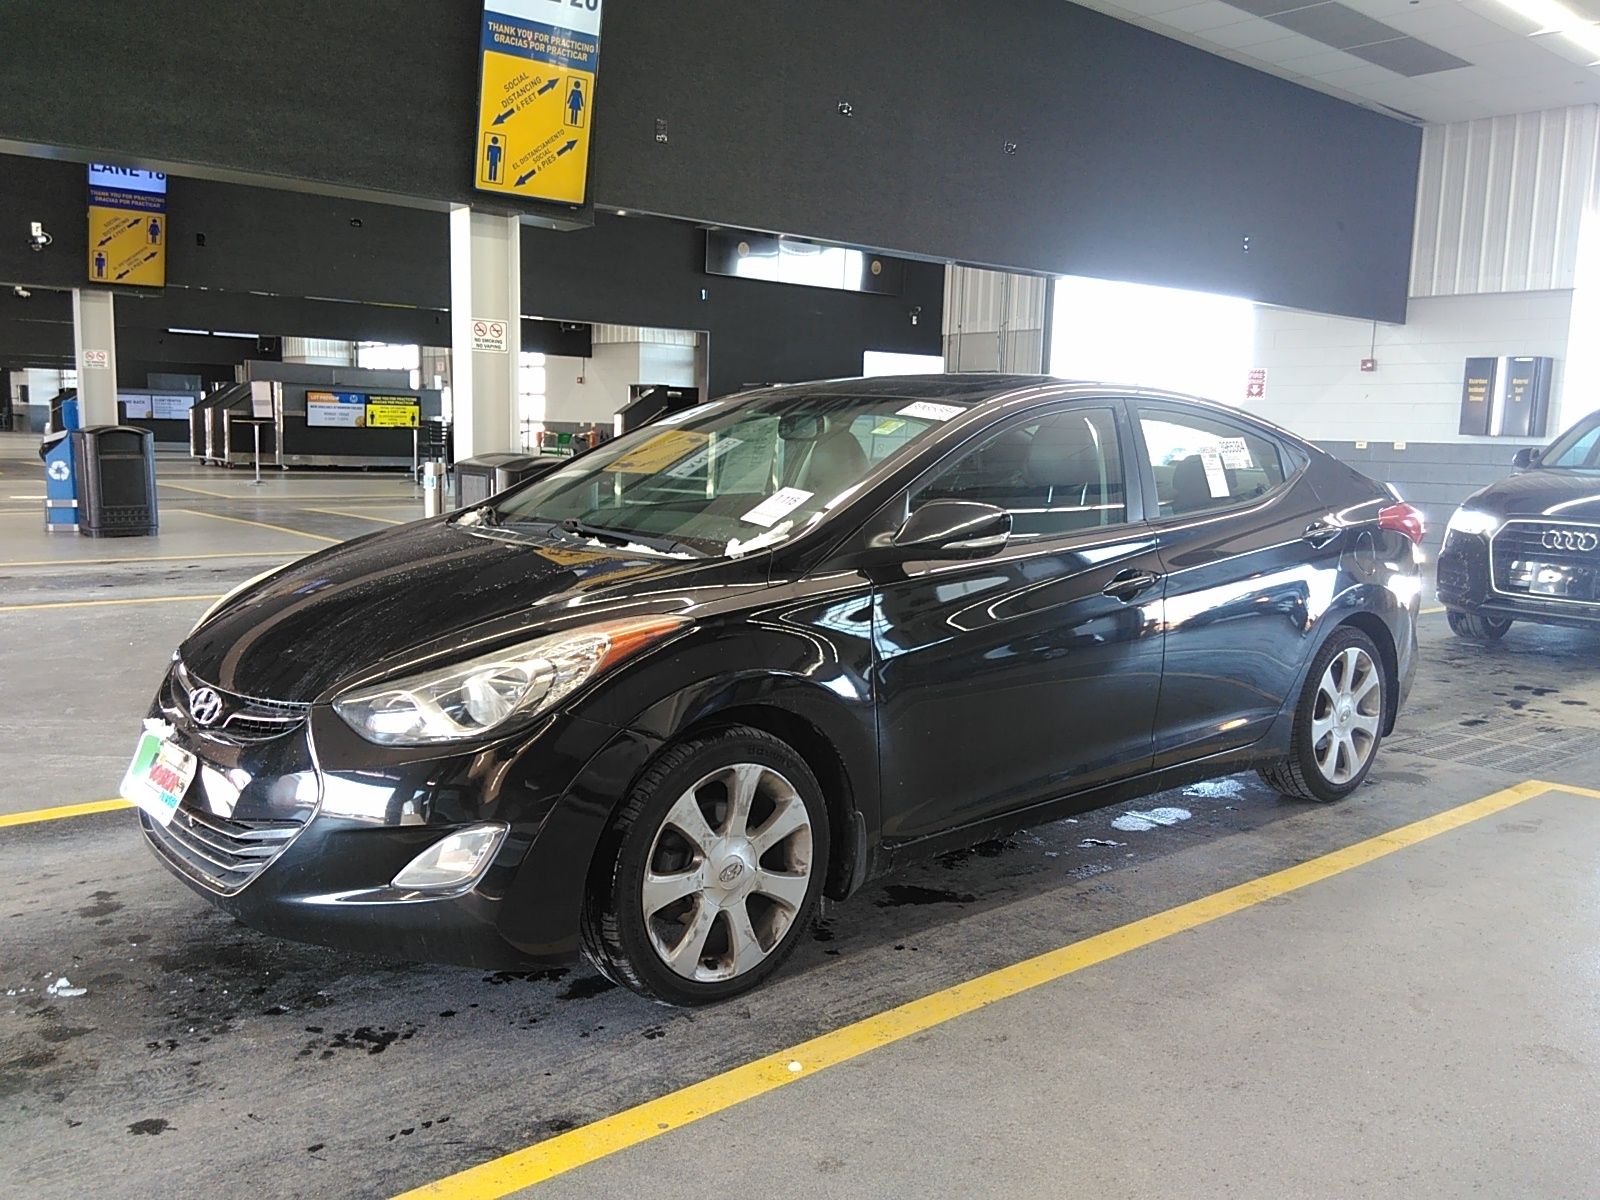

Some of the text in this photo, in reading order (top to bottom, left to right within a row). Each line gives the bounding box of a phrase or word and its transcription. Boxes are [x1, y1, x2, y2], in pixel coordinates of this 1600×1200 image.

[488, 22, 594, 54] THANK YOU FOR PRACTICING
[494, 34, 588, 62] GRACIAS POR PRACTICAR
[501, 76, 542, 108] DISTANCING
[503, 72, 529, 93] SOCIAL
[516, 92, 536, 112] 6 FEET
[512, 129, 564, 170] EL DISTANCIAMIENTO
[532, 148, 552, 164] SOCIAL
[541, 154, 556, 168] PIES
